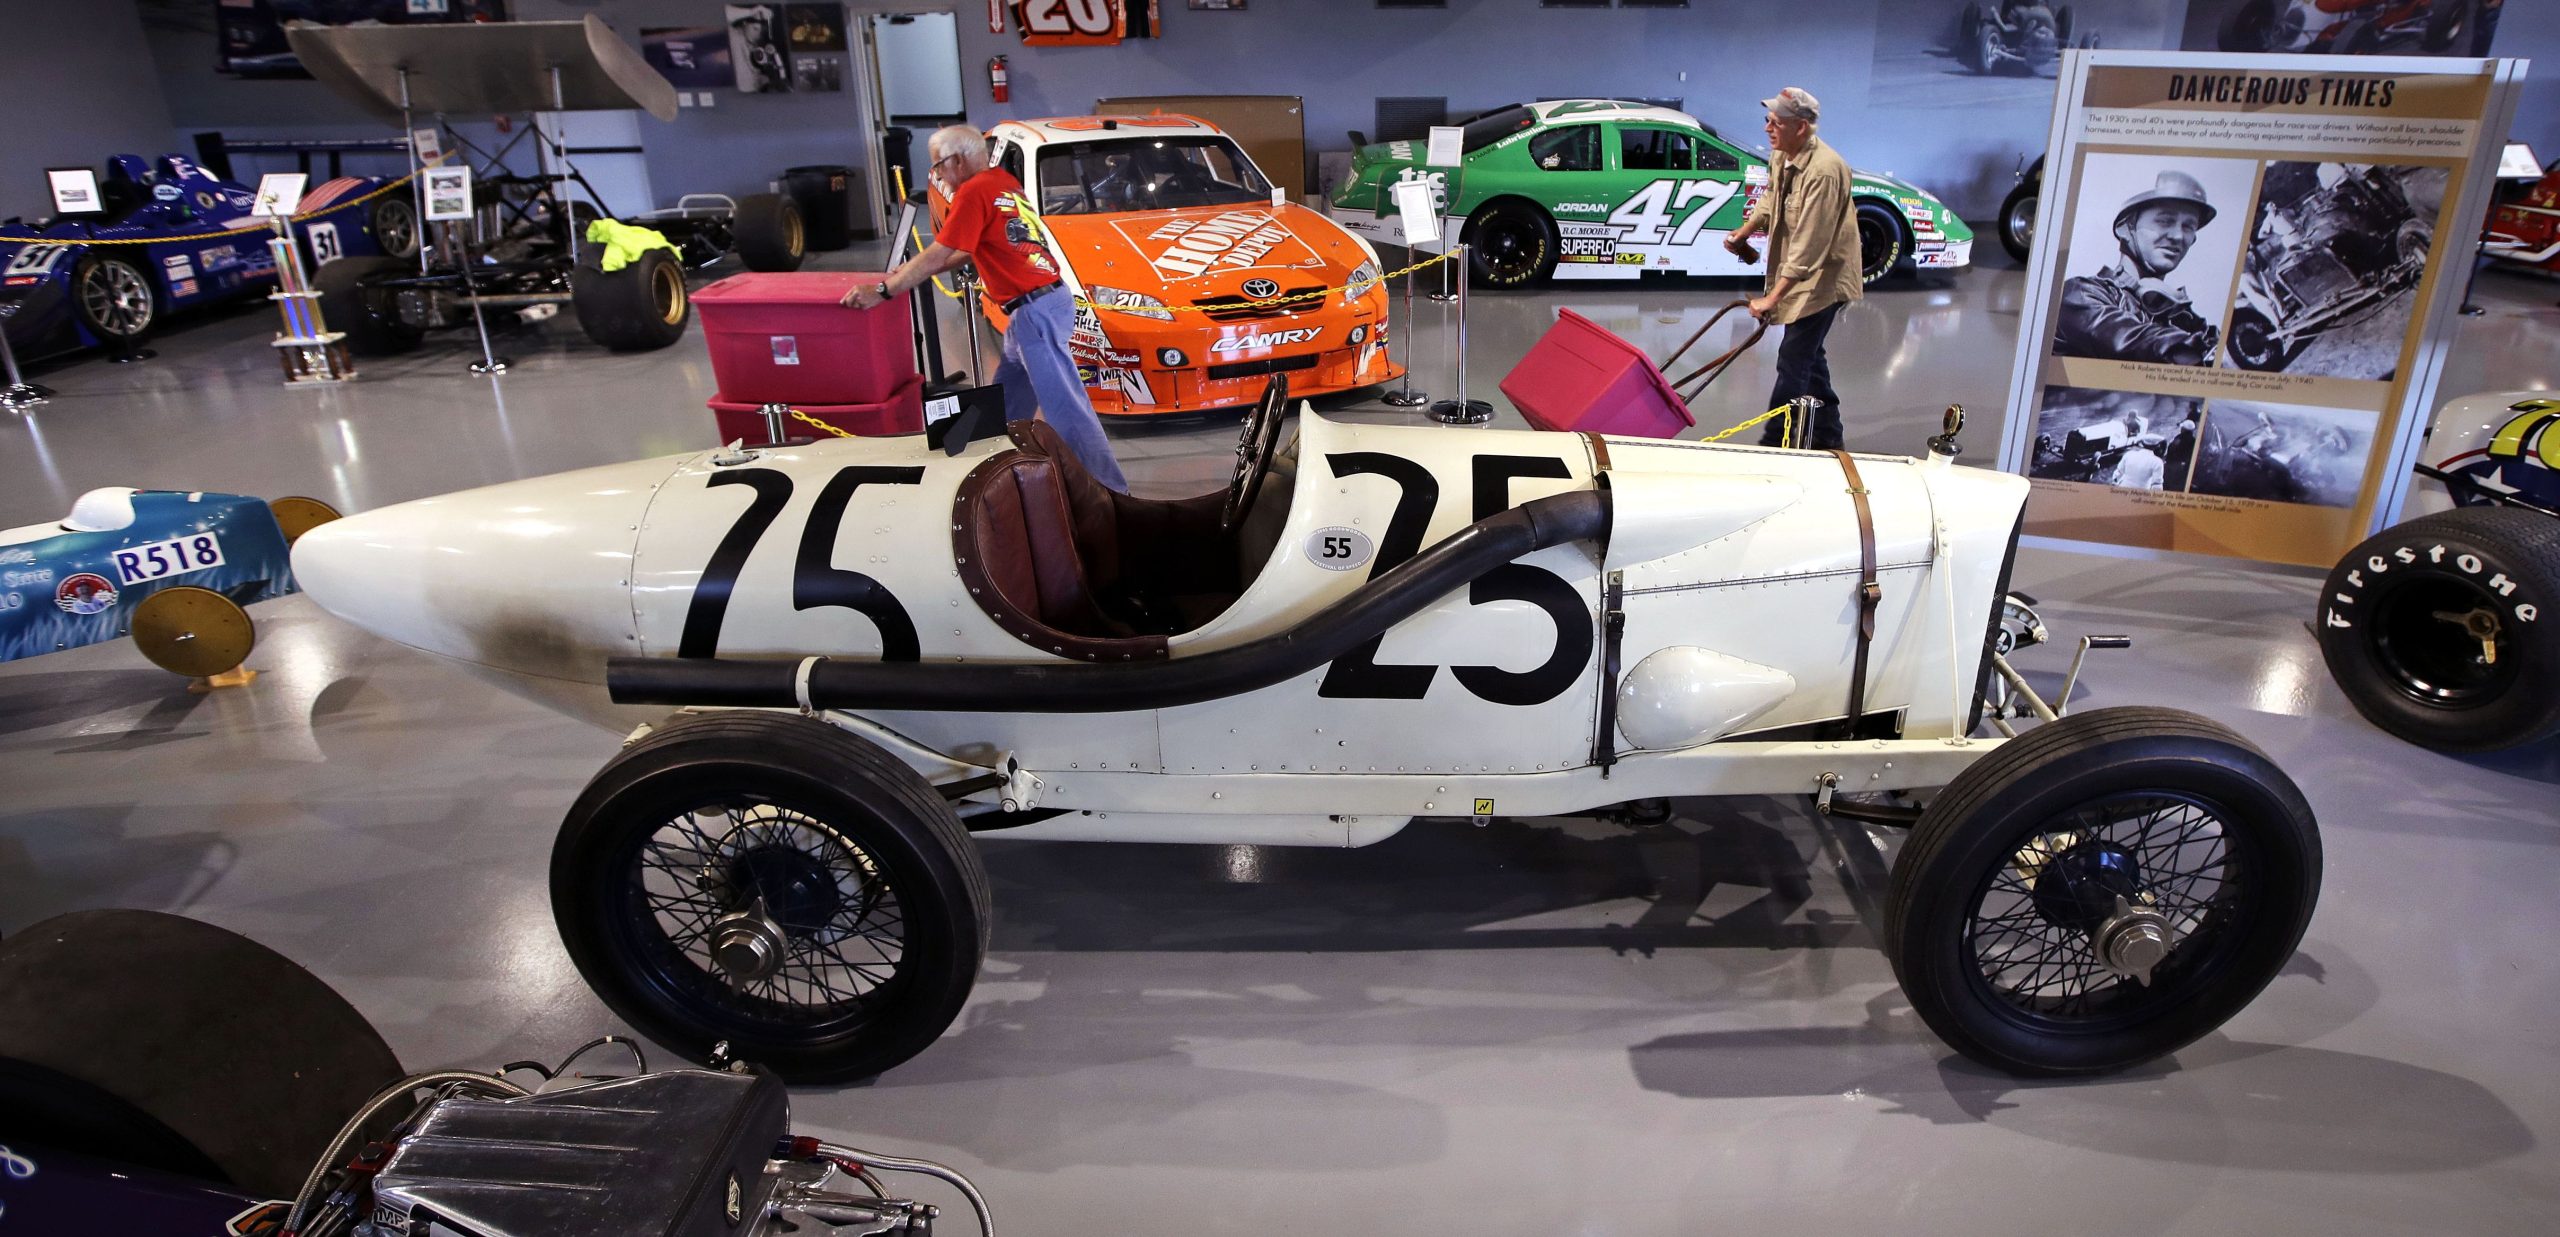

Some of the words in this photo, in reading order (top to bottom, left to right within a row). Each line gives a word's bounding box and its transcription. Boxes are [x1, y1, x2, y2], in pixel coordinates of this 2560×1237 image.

[2168, 74, 2310, 105] DANGEROUS
[2320, 78, 2395, 108] TIMES
[2089, 114, 2101, 122] The
[2105, 115, 2129, 123] 1930's
[2132, 115, 2147, 124] and
[2149, 117, 2164, 125] 40's
[2186, 117, 2228, 128] profoundly
[2230, 118, 2271, 129] dangerous
[2274, 120, 2285, 128] for
[2322, 121, 2351, 131] drivers.
[2356, 123, 2389, 132] Without
[2390, 124, 2405, 132] roll
[2405, 124, 2426, 134] bars,
[2429, 125, 2465, 134] shoulder
[1496, 125, 1548, 149] Lubrication
[2084, 125, 2122, 135] harnesses,
[2135, 127, 2156, 135] much
[2167, 128, 2179, 136] the
[2181, 130, 2197, 138] way
[2199, 129, 2208, 137] of
[2209, 130, 2232, 140] sturdy
[2235, 131, 2259, 141] racing
[2261, 133, 2304, 142] equipment,
[2368, 136, 2415, 146] particularly
[2416, 139, 2462, 147] precarious.
[1553, 203, 1608, 212] JORDAN
[1606, 178, 1743, 246] 47
[1147, 218, 1201, 241] THE
[1578, 227, 1611, 236] MOORE
[315, 226, 337, 261] 31
[1151, 210, 1274, 276] HOME
[1221, 225, 1293, 267] DEPOT
[1561, 239, 1615, 255] SUPERFLO
[1862, 241, 1900, 284] GOODYEA
[1919, 254, 1939, 264] JE
[1114, 293, 1143, 309] 20
[1073, 316, 1101, 332] AHLE
[1211, 326, 1324, 352] CAMRY
[1322, 537, 1352, 558] 55
[117, 537, 217, 582] R518
[1313, 559, 1337, 570] FESTIVAL
[1346, 561, 1361, 570] SPEED
[1317, 452, 1594, 706] 25
[2326, 544, 2538, 629] Firestone
